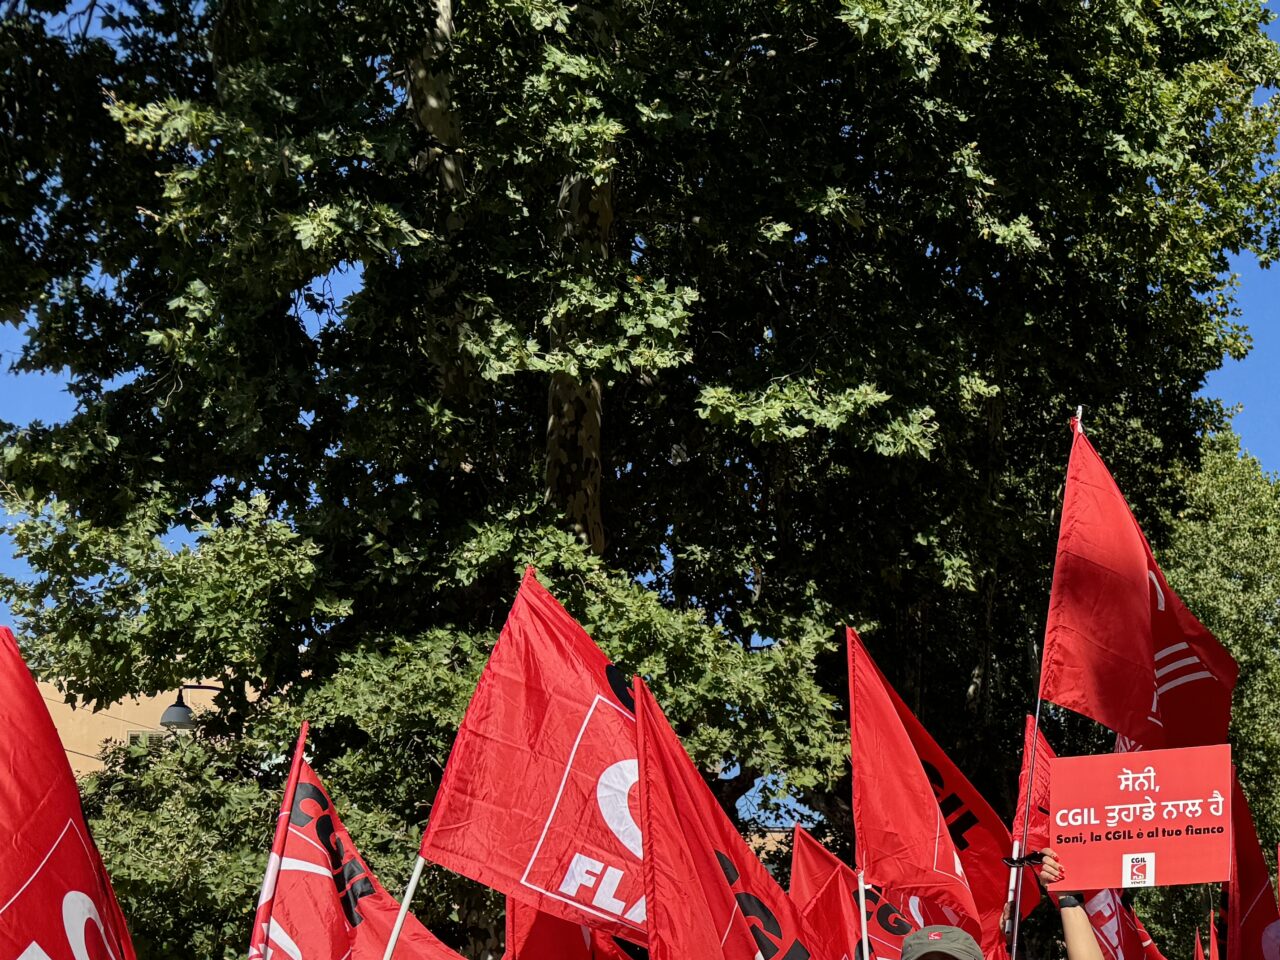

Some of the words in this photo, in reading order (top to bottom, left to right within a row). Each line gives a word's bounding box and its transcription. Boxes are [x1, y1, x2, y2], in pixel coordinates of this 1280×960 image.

[1055, 808, 1100, 826] CGIL
[1161, 799, 1203, 819] ਨਾਲ
[1207, 790, 1225, 816] ਹੈ
[1056, 834, 1087, 844] Soni,
[1090, 832, 1101, 841] la
[1105, 830, 1133, 840] CGIL
[1136, 828, 1144, 838] è
[1147, 827, 1158, 837] al
[1162, 827, 1182, 837] tuo
[1185, 825, 1224, 835] fianco
